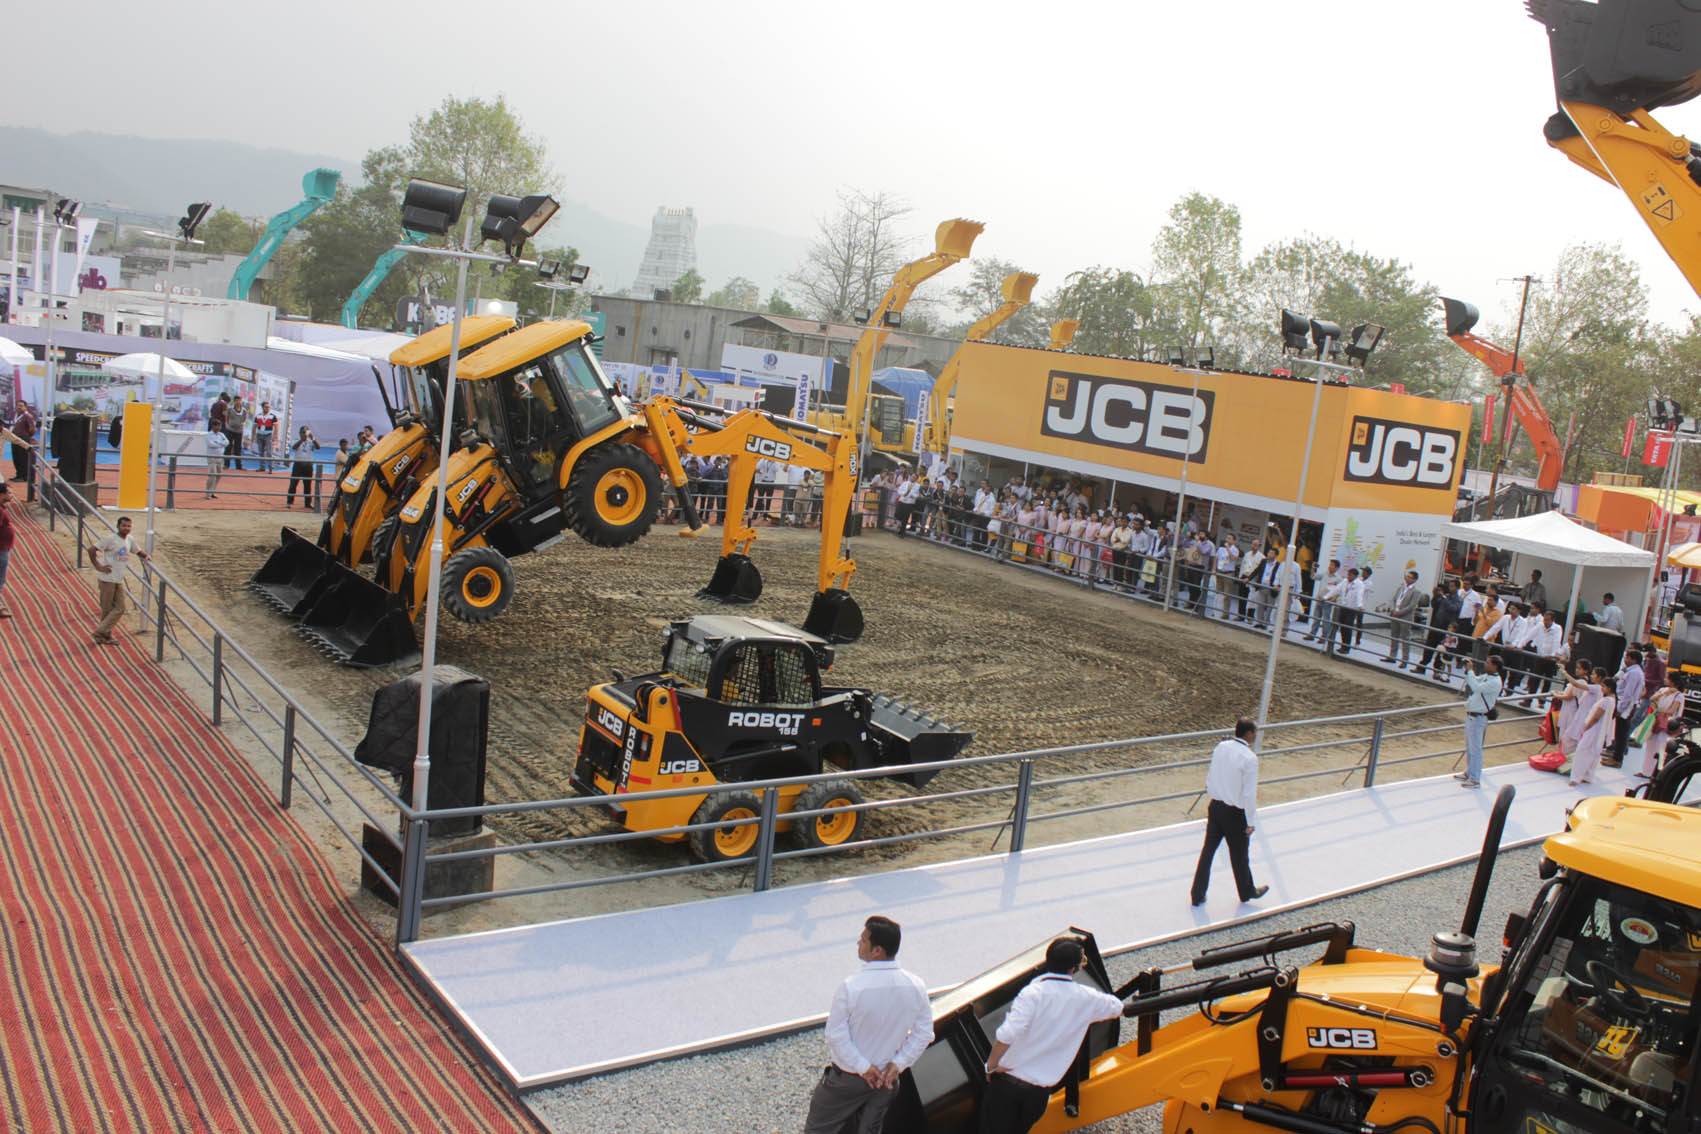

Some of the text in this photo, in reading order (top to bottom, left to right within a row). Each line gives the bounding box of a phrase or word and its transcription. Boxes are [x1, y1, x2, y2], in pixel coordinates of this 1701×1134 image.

[798, 374, 808, 420] OMATSU
[1047, 380, 1206, 454] JCB
[746, 436, 790, 460] JCB
[1349, 424, 1455, 484] JCB
[392, 455, 410, 475] JCB
[457, 479, 478, 502] JCB
[1683, 689, 1701, 699] JC
[598, 710, 623, 736] JCB
[728, 711, 806, 728] ROBOT
[620, 726, 637, 788] ROBOT
[660, 760, 700, 774] JCB
[1309, 1028, 1377, 1049] JCB
